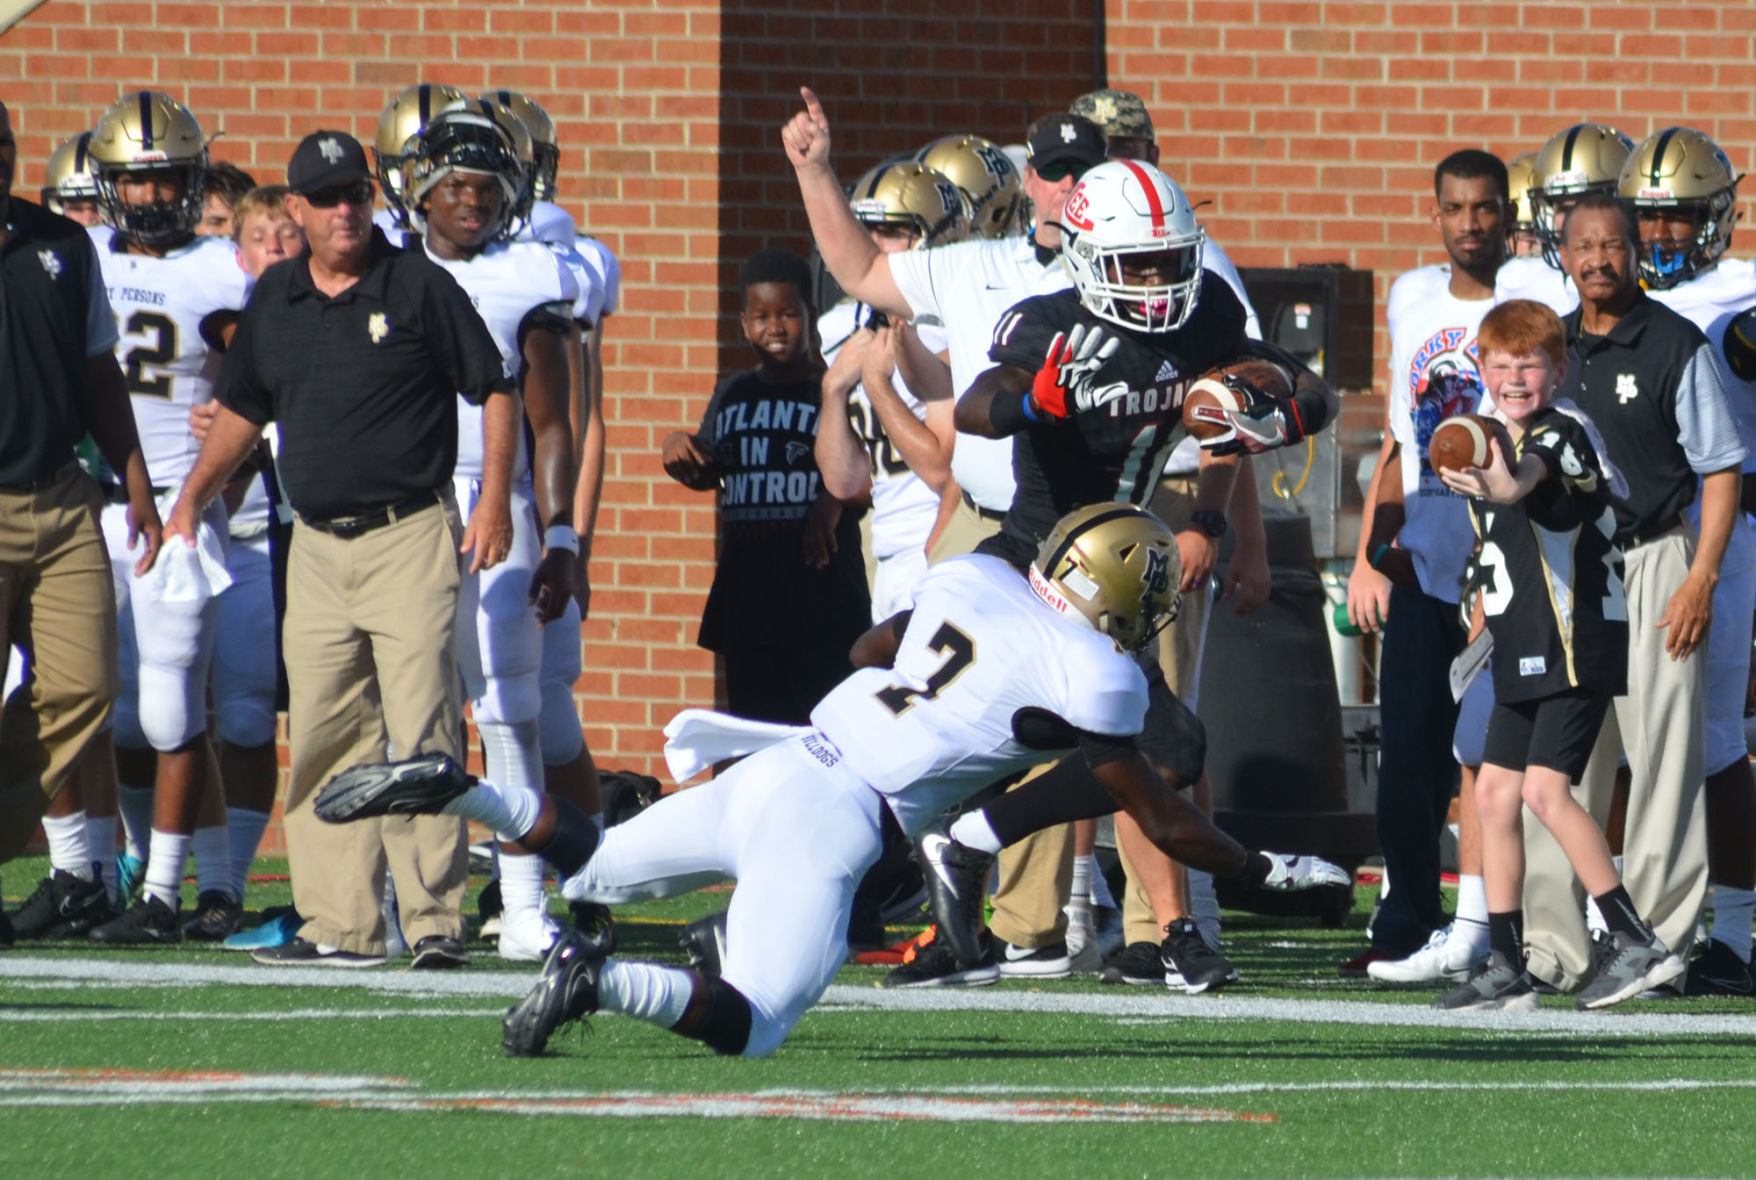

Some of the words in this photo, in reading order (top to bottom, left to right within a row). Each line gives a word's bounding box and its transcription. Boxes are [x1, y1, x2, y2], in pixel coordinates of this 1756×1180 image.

[740, 437, 769, 466] IN
[721, 471, 819, 506] ONTROL
[872, 618, 977, 720] 7
